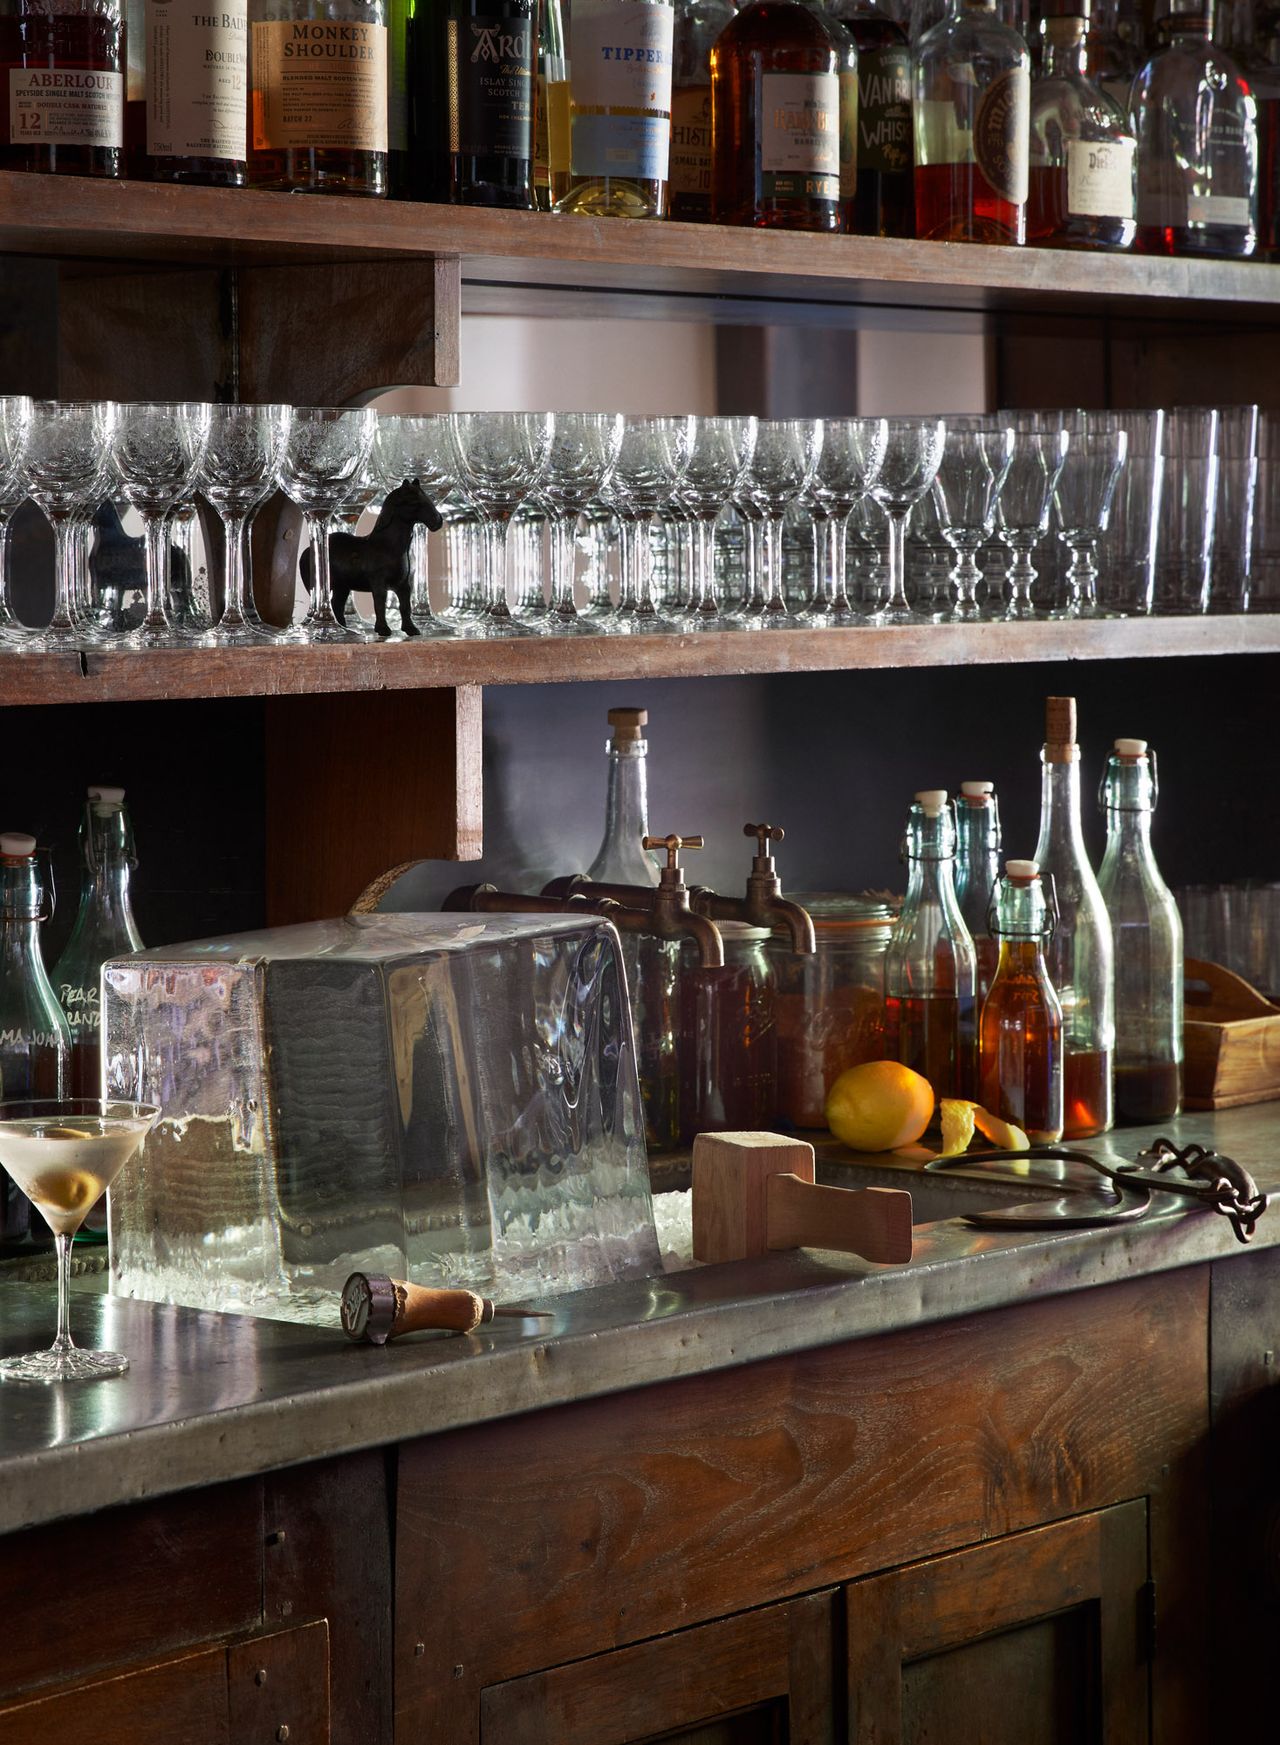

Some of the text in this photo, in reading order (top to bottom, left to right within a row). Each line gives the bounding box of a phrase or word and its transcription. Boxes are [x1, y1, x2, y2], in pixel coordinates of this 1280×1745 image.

[191, 15, 219, 27] THE
[292, 25, 368, 41] MONKEY
[284, 42, 375, 60] SHOULDER
[28, 73, 113, 90] ABERLOUR
[479, 76, 505, 87] ISLAY
[15, 89, 44, 97] SPEYSIDE
[487, 88, 521, 98] SCOTCH
[859, 73, 892, 109] VAN
[20, 113, 41, 129] 12
[674, 156, 697, 166] SMALL
[806, 181, 829, 193] RYE
[60, 983, 100, 1008] PEAR
